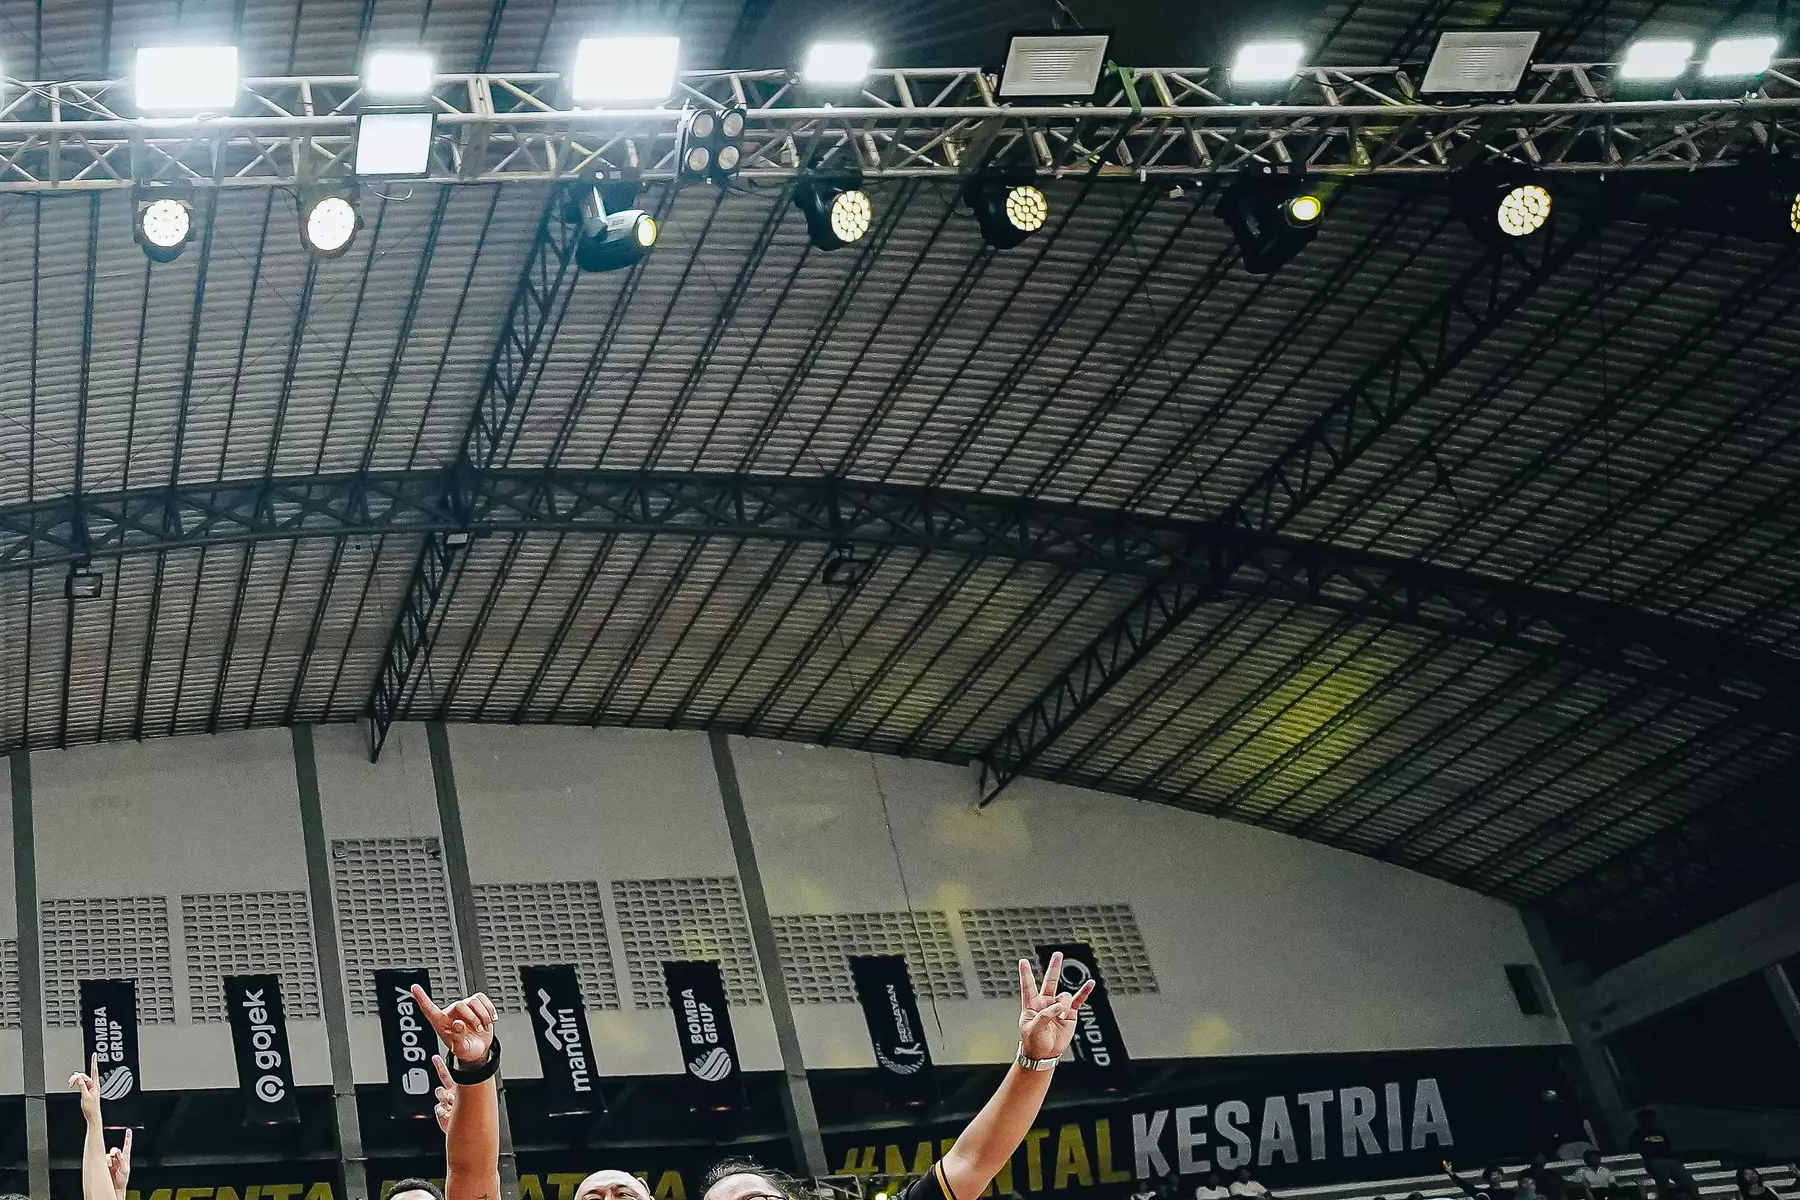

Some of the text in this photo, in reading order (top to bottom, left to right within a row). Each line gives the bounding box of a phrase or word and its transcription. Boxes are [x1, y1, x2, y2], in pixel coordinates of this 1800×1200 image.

[94, 1006, 109, 1062] BOMBA
[109, 1020, 124, 1061] GRUP
[242, 988, 282, 1070] gojek
[395, 986, 426, 1062] gopay
[681, 988, 704, 1045] BOMBA
[699, 1002, 718, 1044] GRUP
[557, 1008, 591, 1092] mandiri
[1091, 1046, 1111, 1067] ID
